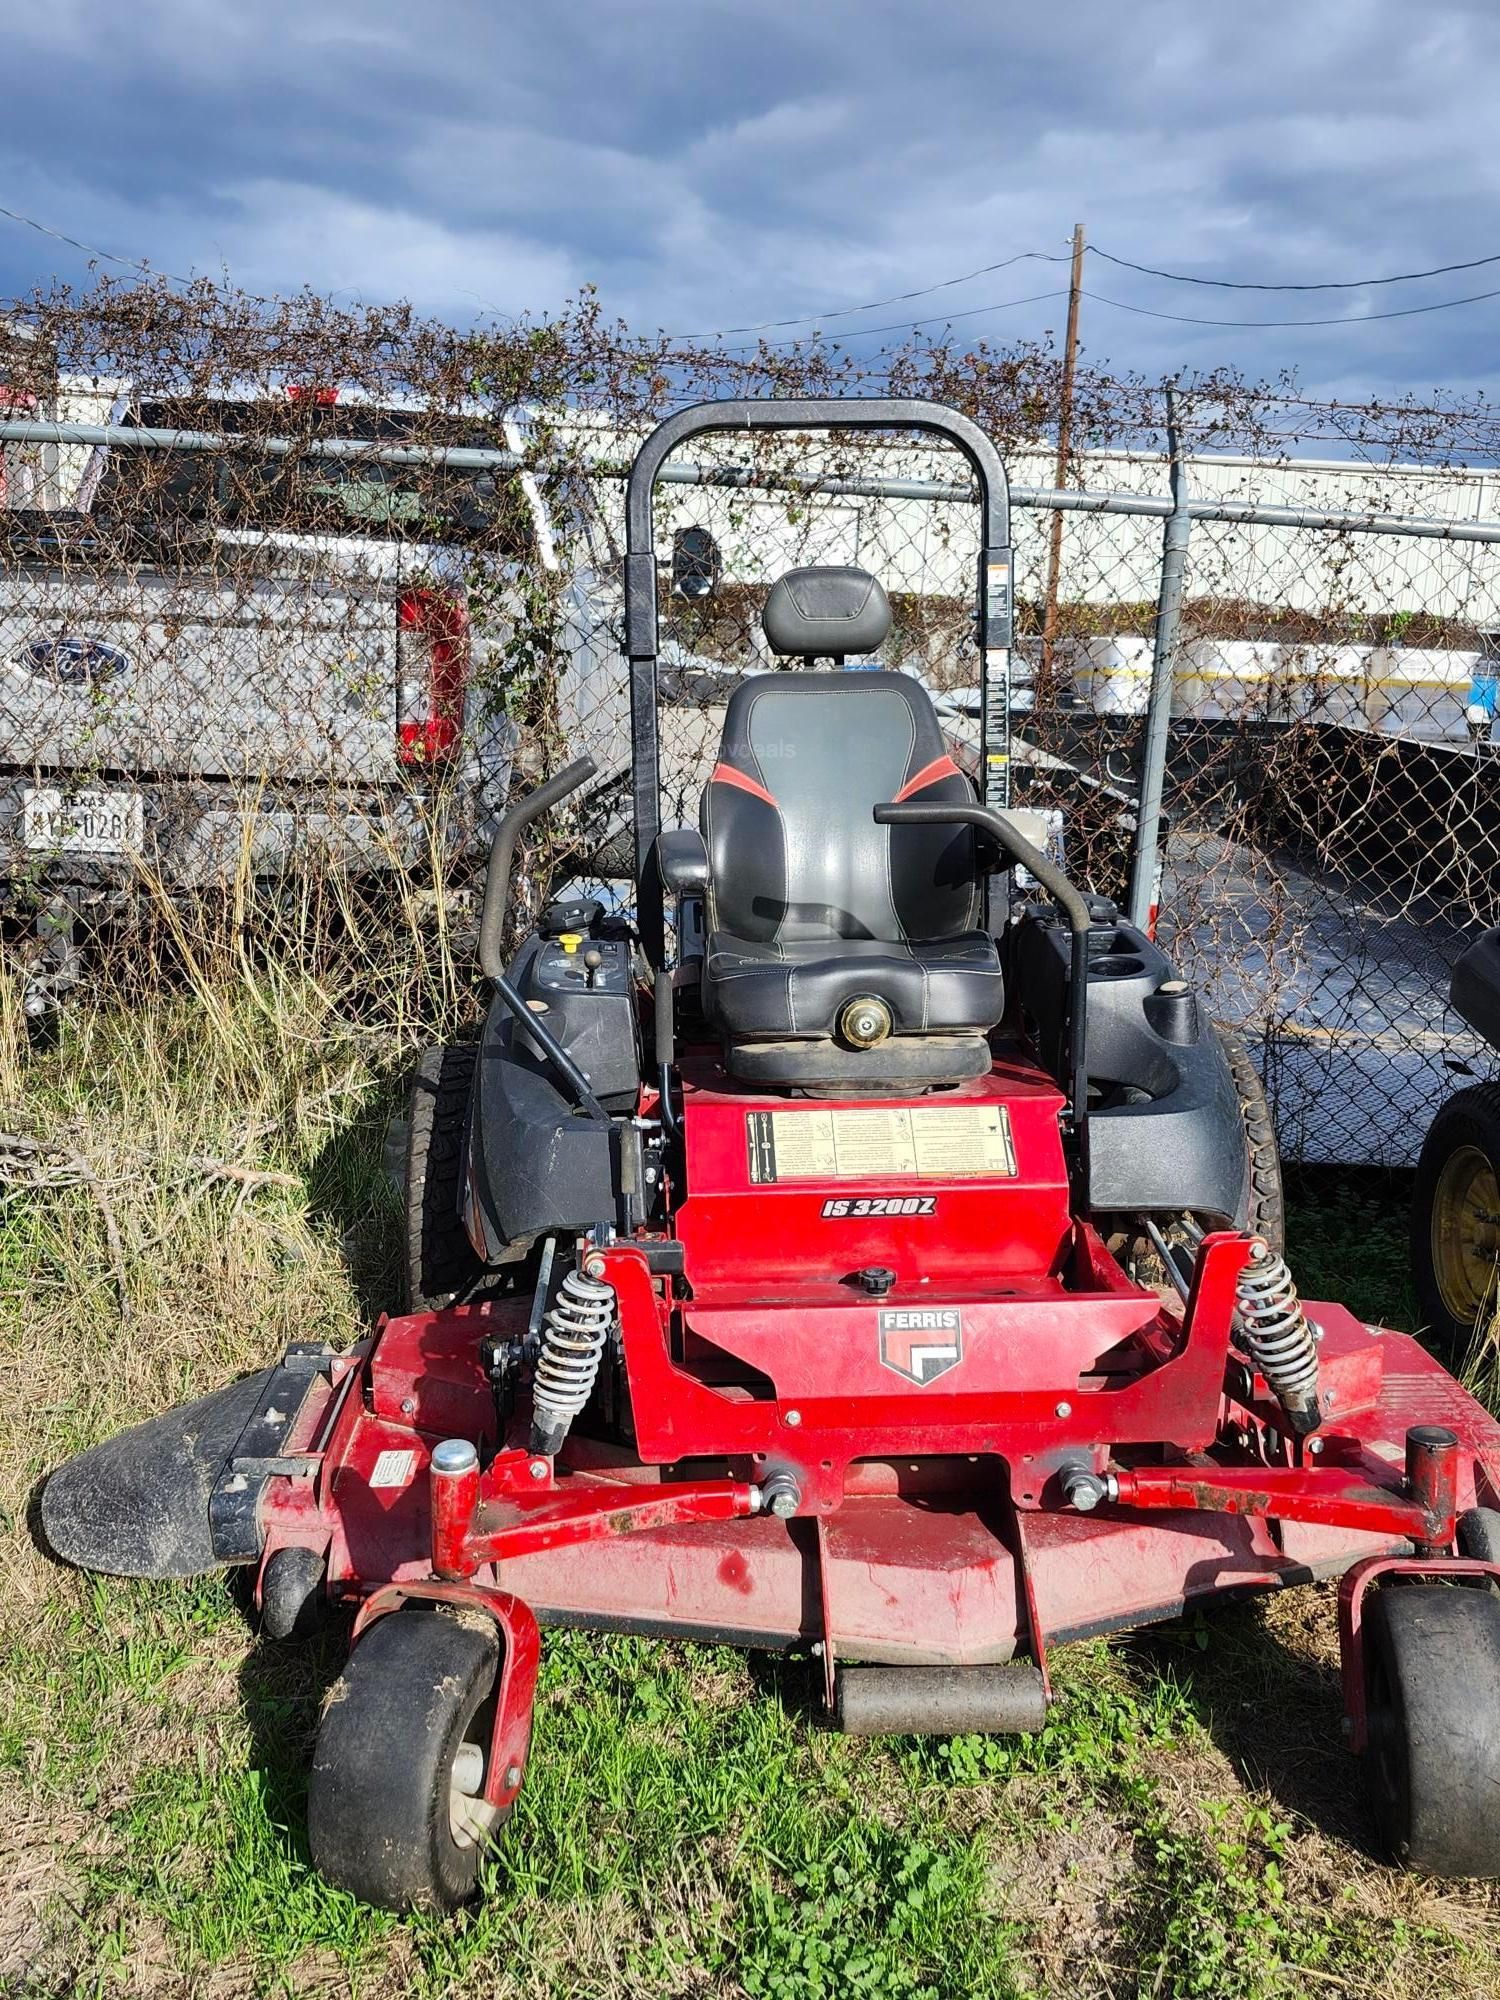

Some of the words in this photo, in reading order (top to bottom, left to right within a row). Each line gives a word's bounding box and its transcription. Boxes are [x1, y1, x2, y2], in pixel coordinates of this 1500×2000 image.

[822, 1200, 850, 1217] IS
[851, 1198, 936, 1215] 3200Z
[884, 1311, 956, 1329] FERRIS
